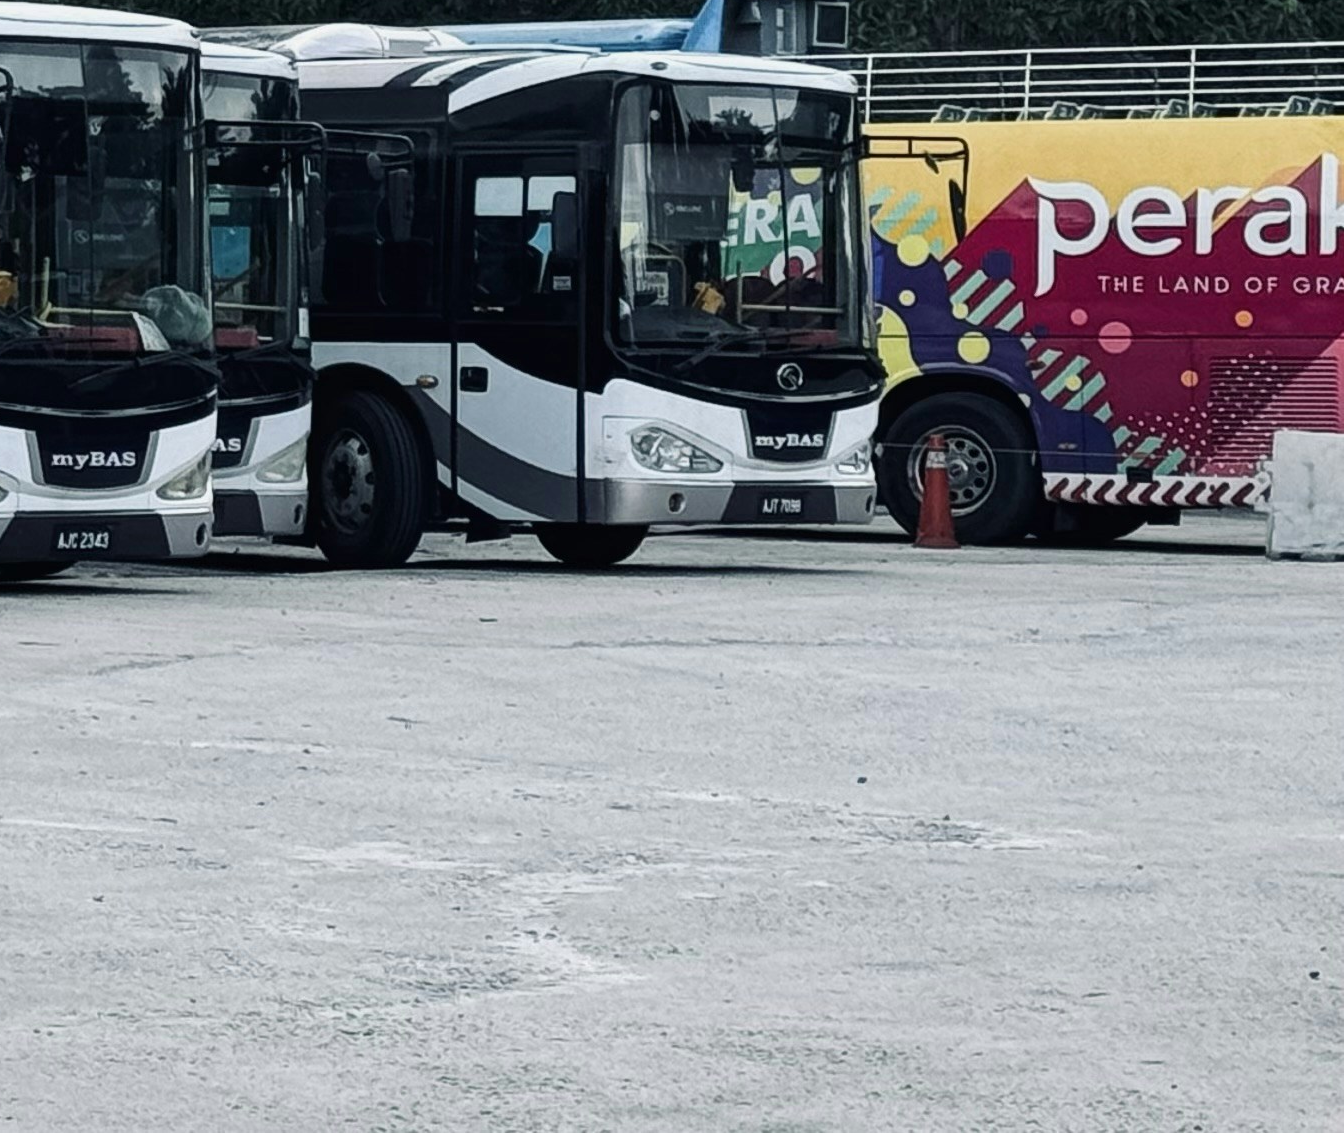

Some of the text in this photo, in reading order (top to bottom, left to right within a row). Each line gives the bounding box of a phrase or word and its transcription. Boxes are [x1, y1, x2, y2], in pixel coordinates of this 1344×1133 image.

[1097, 275, 1145, 294] THE
[1159, 275, 1230, 294] LAND
[1244, 276, 1279, 294] OF
[755, 433, 824, 449] myBAS
[51, 451, 136, 470] myBAS
[57, 532, 109, 549] AJC 2343
